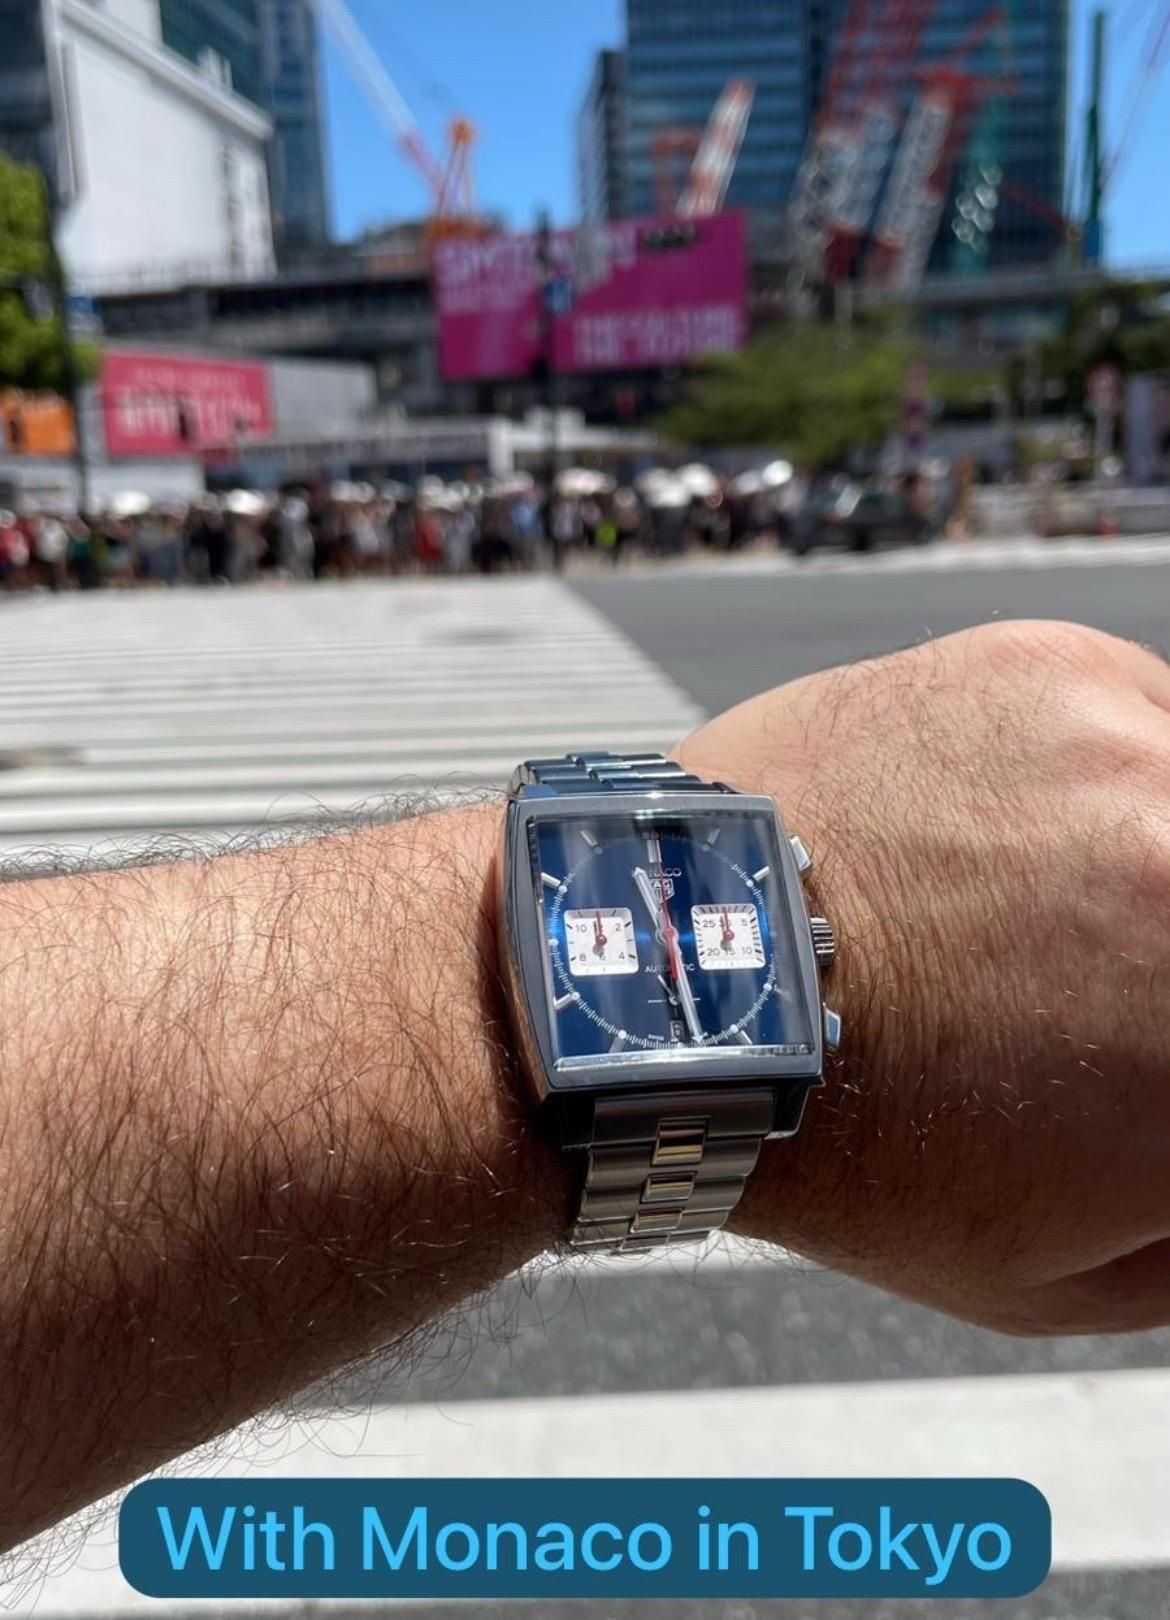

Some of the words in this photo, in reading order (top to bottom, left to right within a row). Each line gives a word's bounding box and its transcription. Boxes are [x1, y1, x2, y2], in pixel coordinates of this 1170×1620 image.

[576, 924, 587, 933] 10
[615, 922, 622, 932] 2
[706, 947, 719, 957] 20
[741, 946, 753, 955] 10
